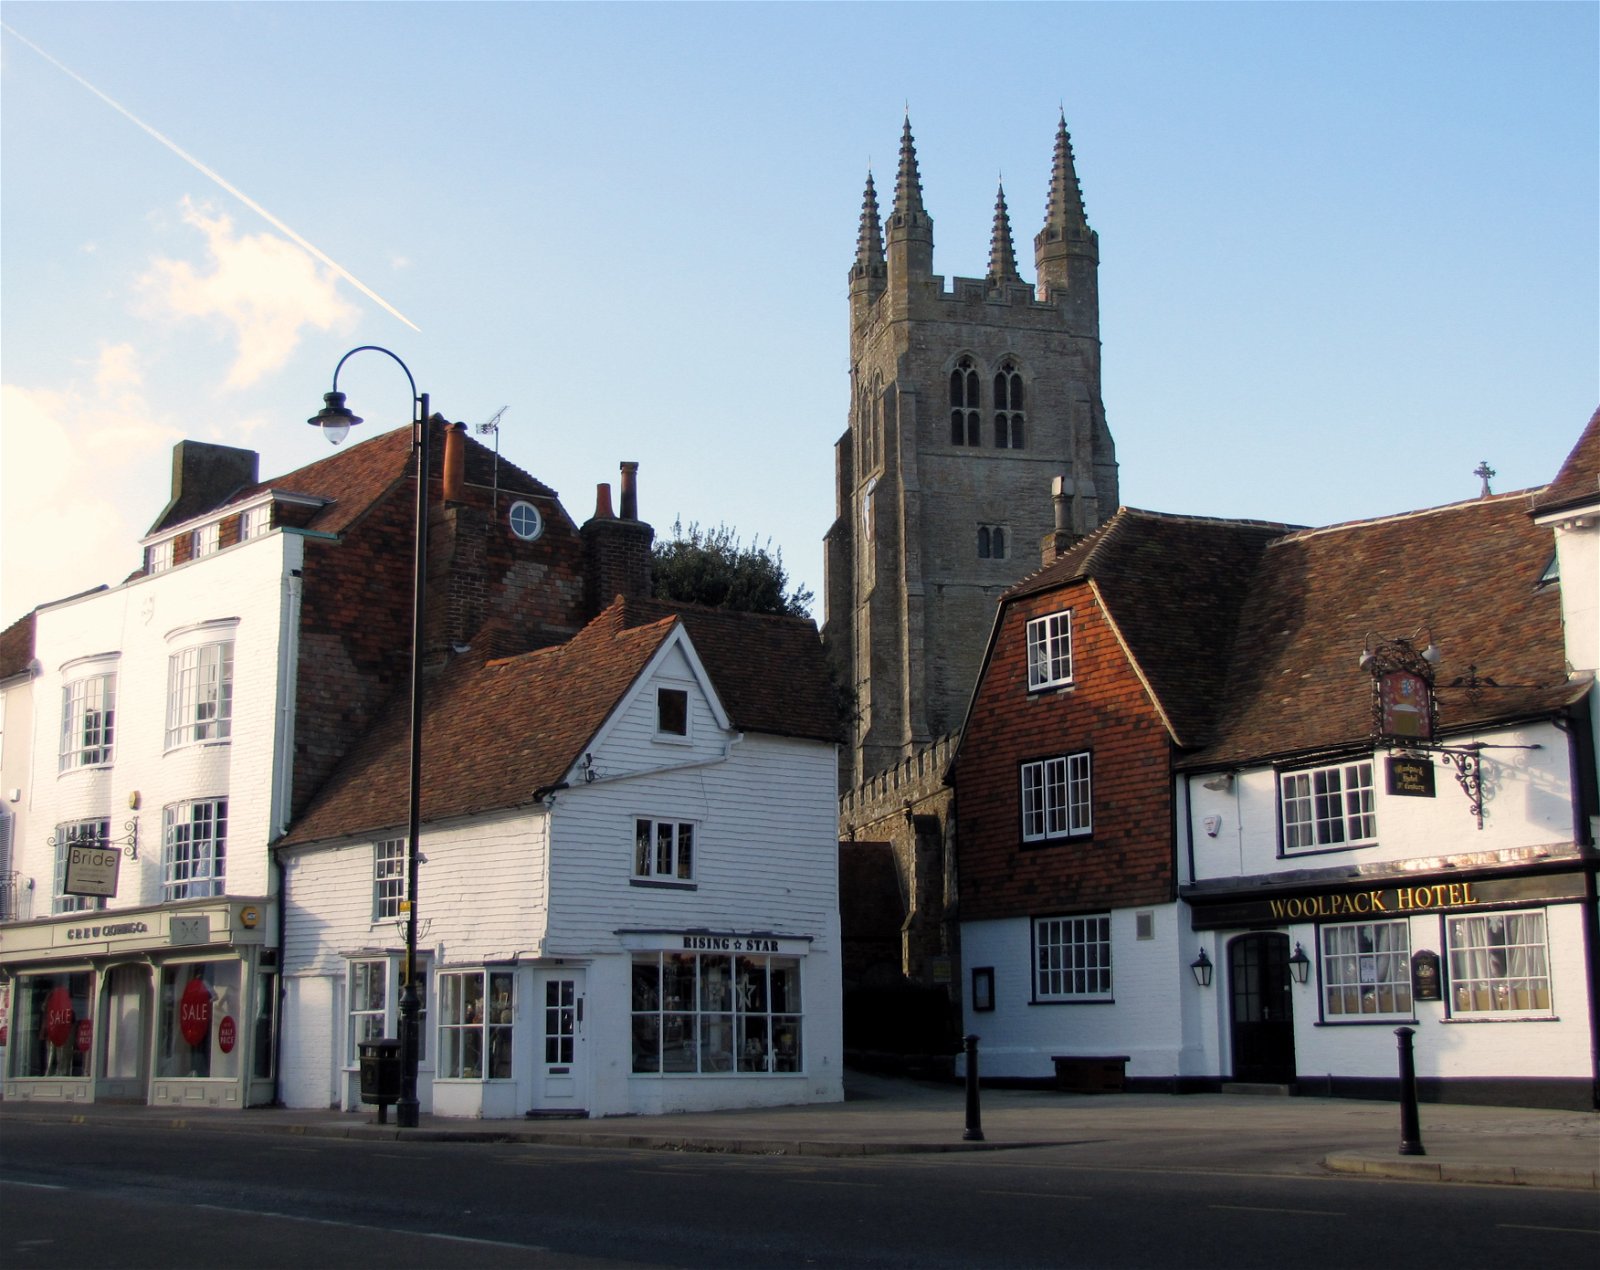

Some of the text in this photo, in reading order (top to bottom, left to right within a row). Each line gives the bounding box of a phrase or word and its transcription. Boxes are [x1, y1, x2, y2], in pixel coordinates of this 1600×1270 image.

[72, 849, 115, 867] Bride
[1270, 882, 1478, 919] WOOLPACK HOTEL
[67, 926, 101, 940] CREW
[683, 936, 779, 952] RISING STAR
[50, 1008, 71, 1025] SALE
[182, 1003, 208, 1021] SALE
[220, 1036, 234, 1044] PRICE
[221, 1028, 233, 1036] HALF
